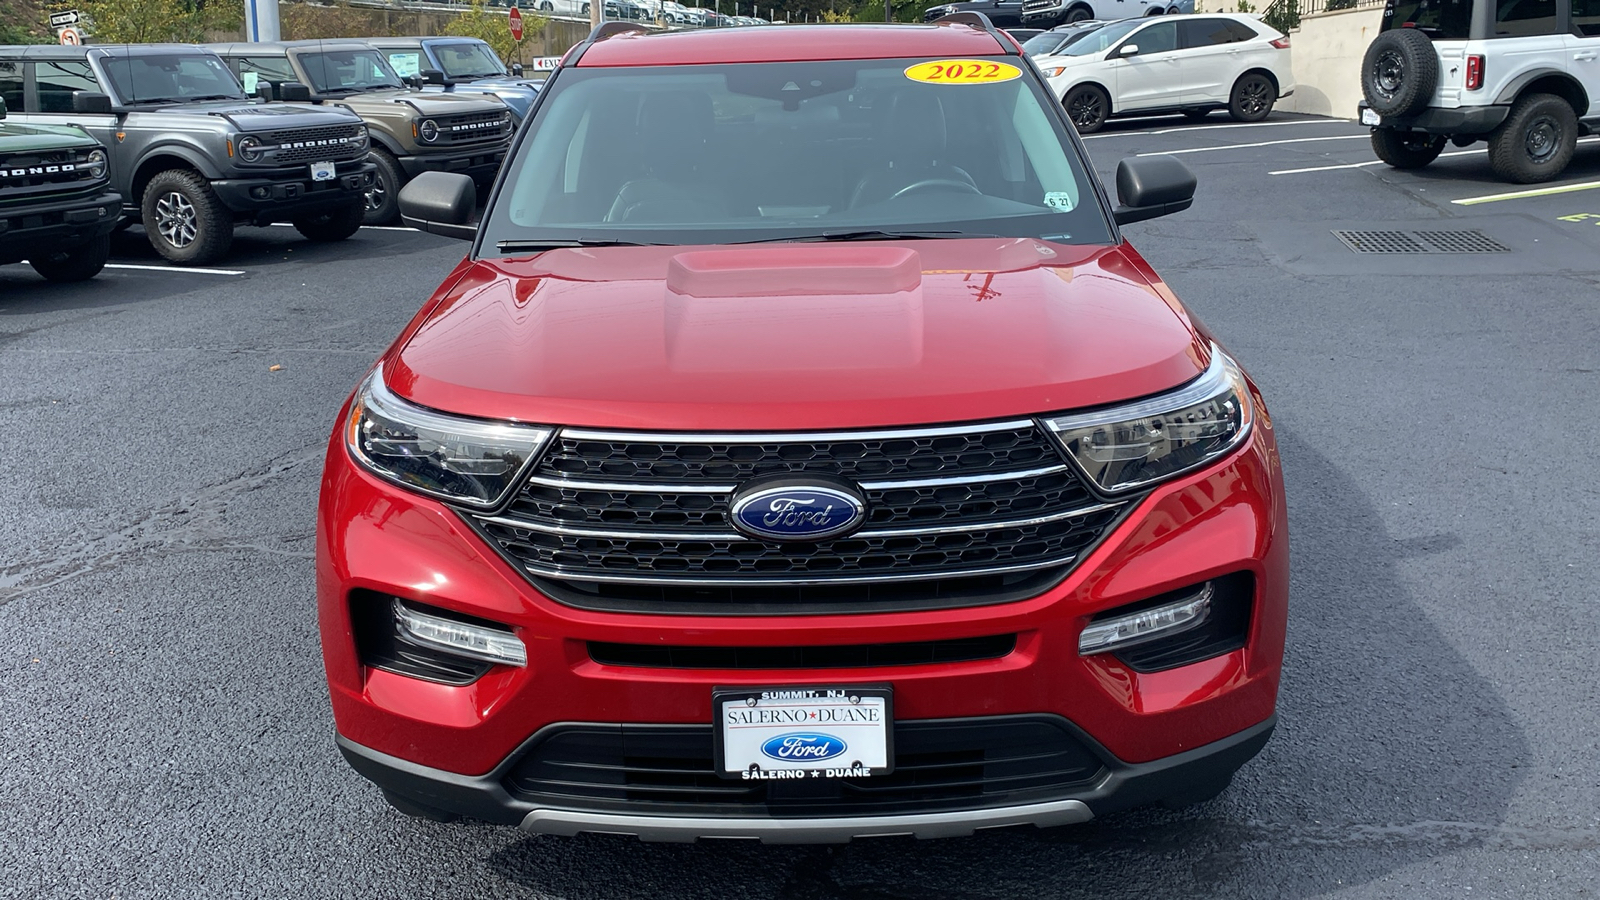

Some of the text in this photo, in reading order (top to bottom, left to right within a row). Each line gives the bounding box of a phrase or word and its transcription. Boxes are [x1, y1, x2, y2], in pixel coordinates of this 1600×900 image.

[510, 17, 521, 30] STOP
[926, 64, 1000, 80] 2022
[452, 121, 499, 131] BRONCO
[280, 138, 348, 149] BRONCO
[1049, 198, 1069, 207] 6 27
[763, 498, 833, 527] Ford
[761, 690, 846, 700] SUMMIT, NJ
[728, 708, 880, 725] SALERNO DUANE
[778, 736, 829, 757] Ford
[741, 767, 871, 780] SALERNO DUANE
